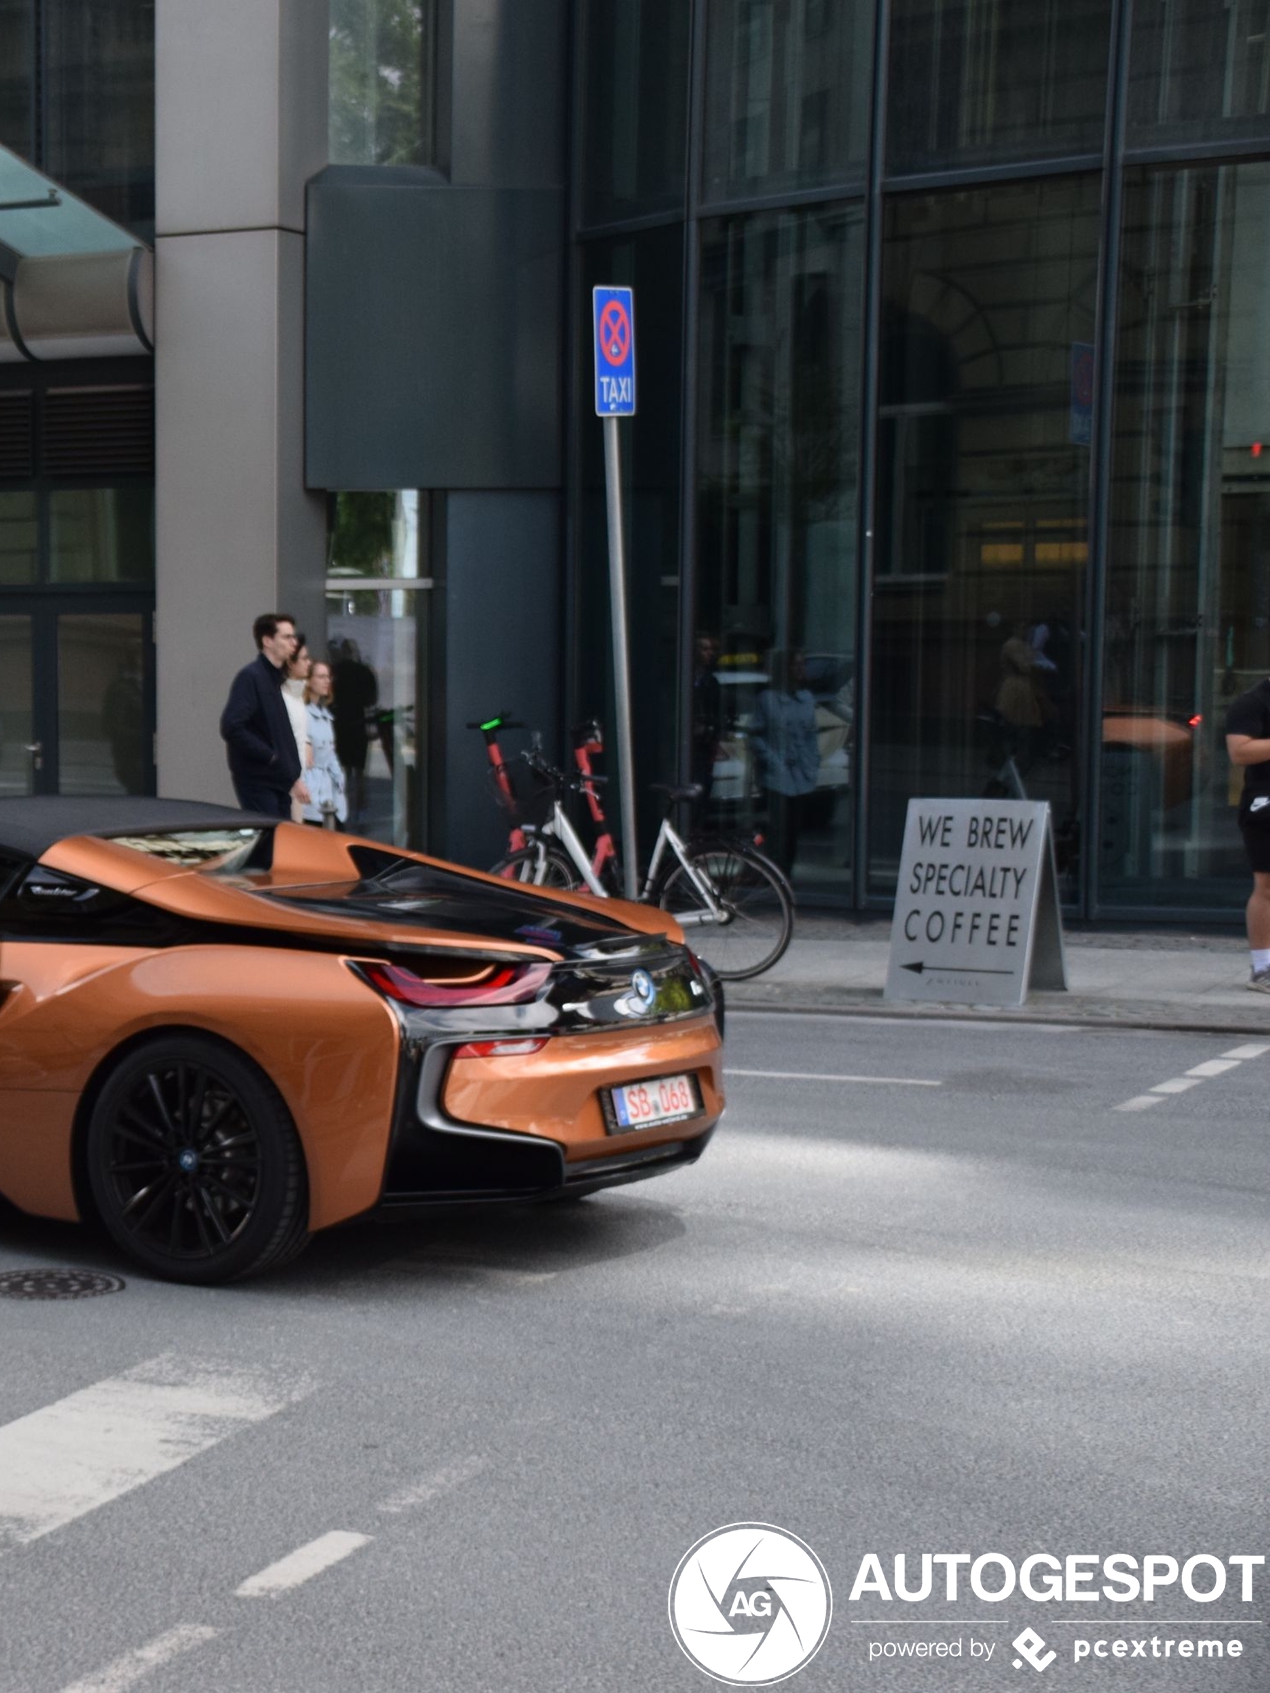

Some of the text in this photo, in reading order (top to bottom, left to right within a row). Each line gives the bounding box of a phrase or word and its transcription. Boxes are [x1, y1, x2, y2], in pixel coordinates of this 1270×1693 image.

[599, 376, 632, 403] TAXI
[919, 815, 1035, 850] WE BREW
[909, 862, 1027, 900] SPECIALTY
[904, 909, 1021, 947] COFFEE
[627, 1088, 651, 1119] SB
